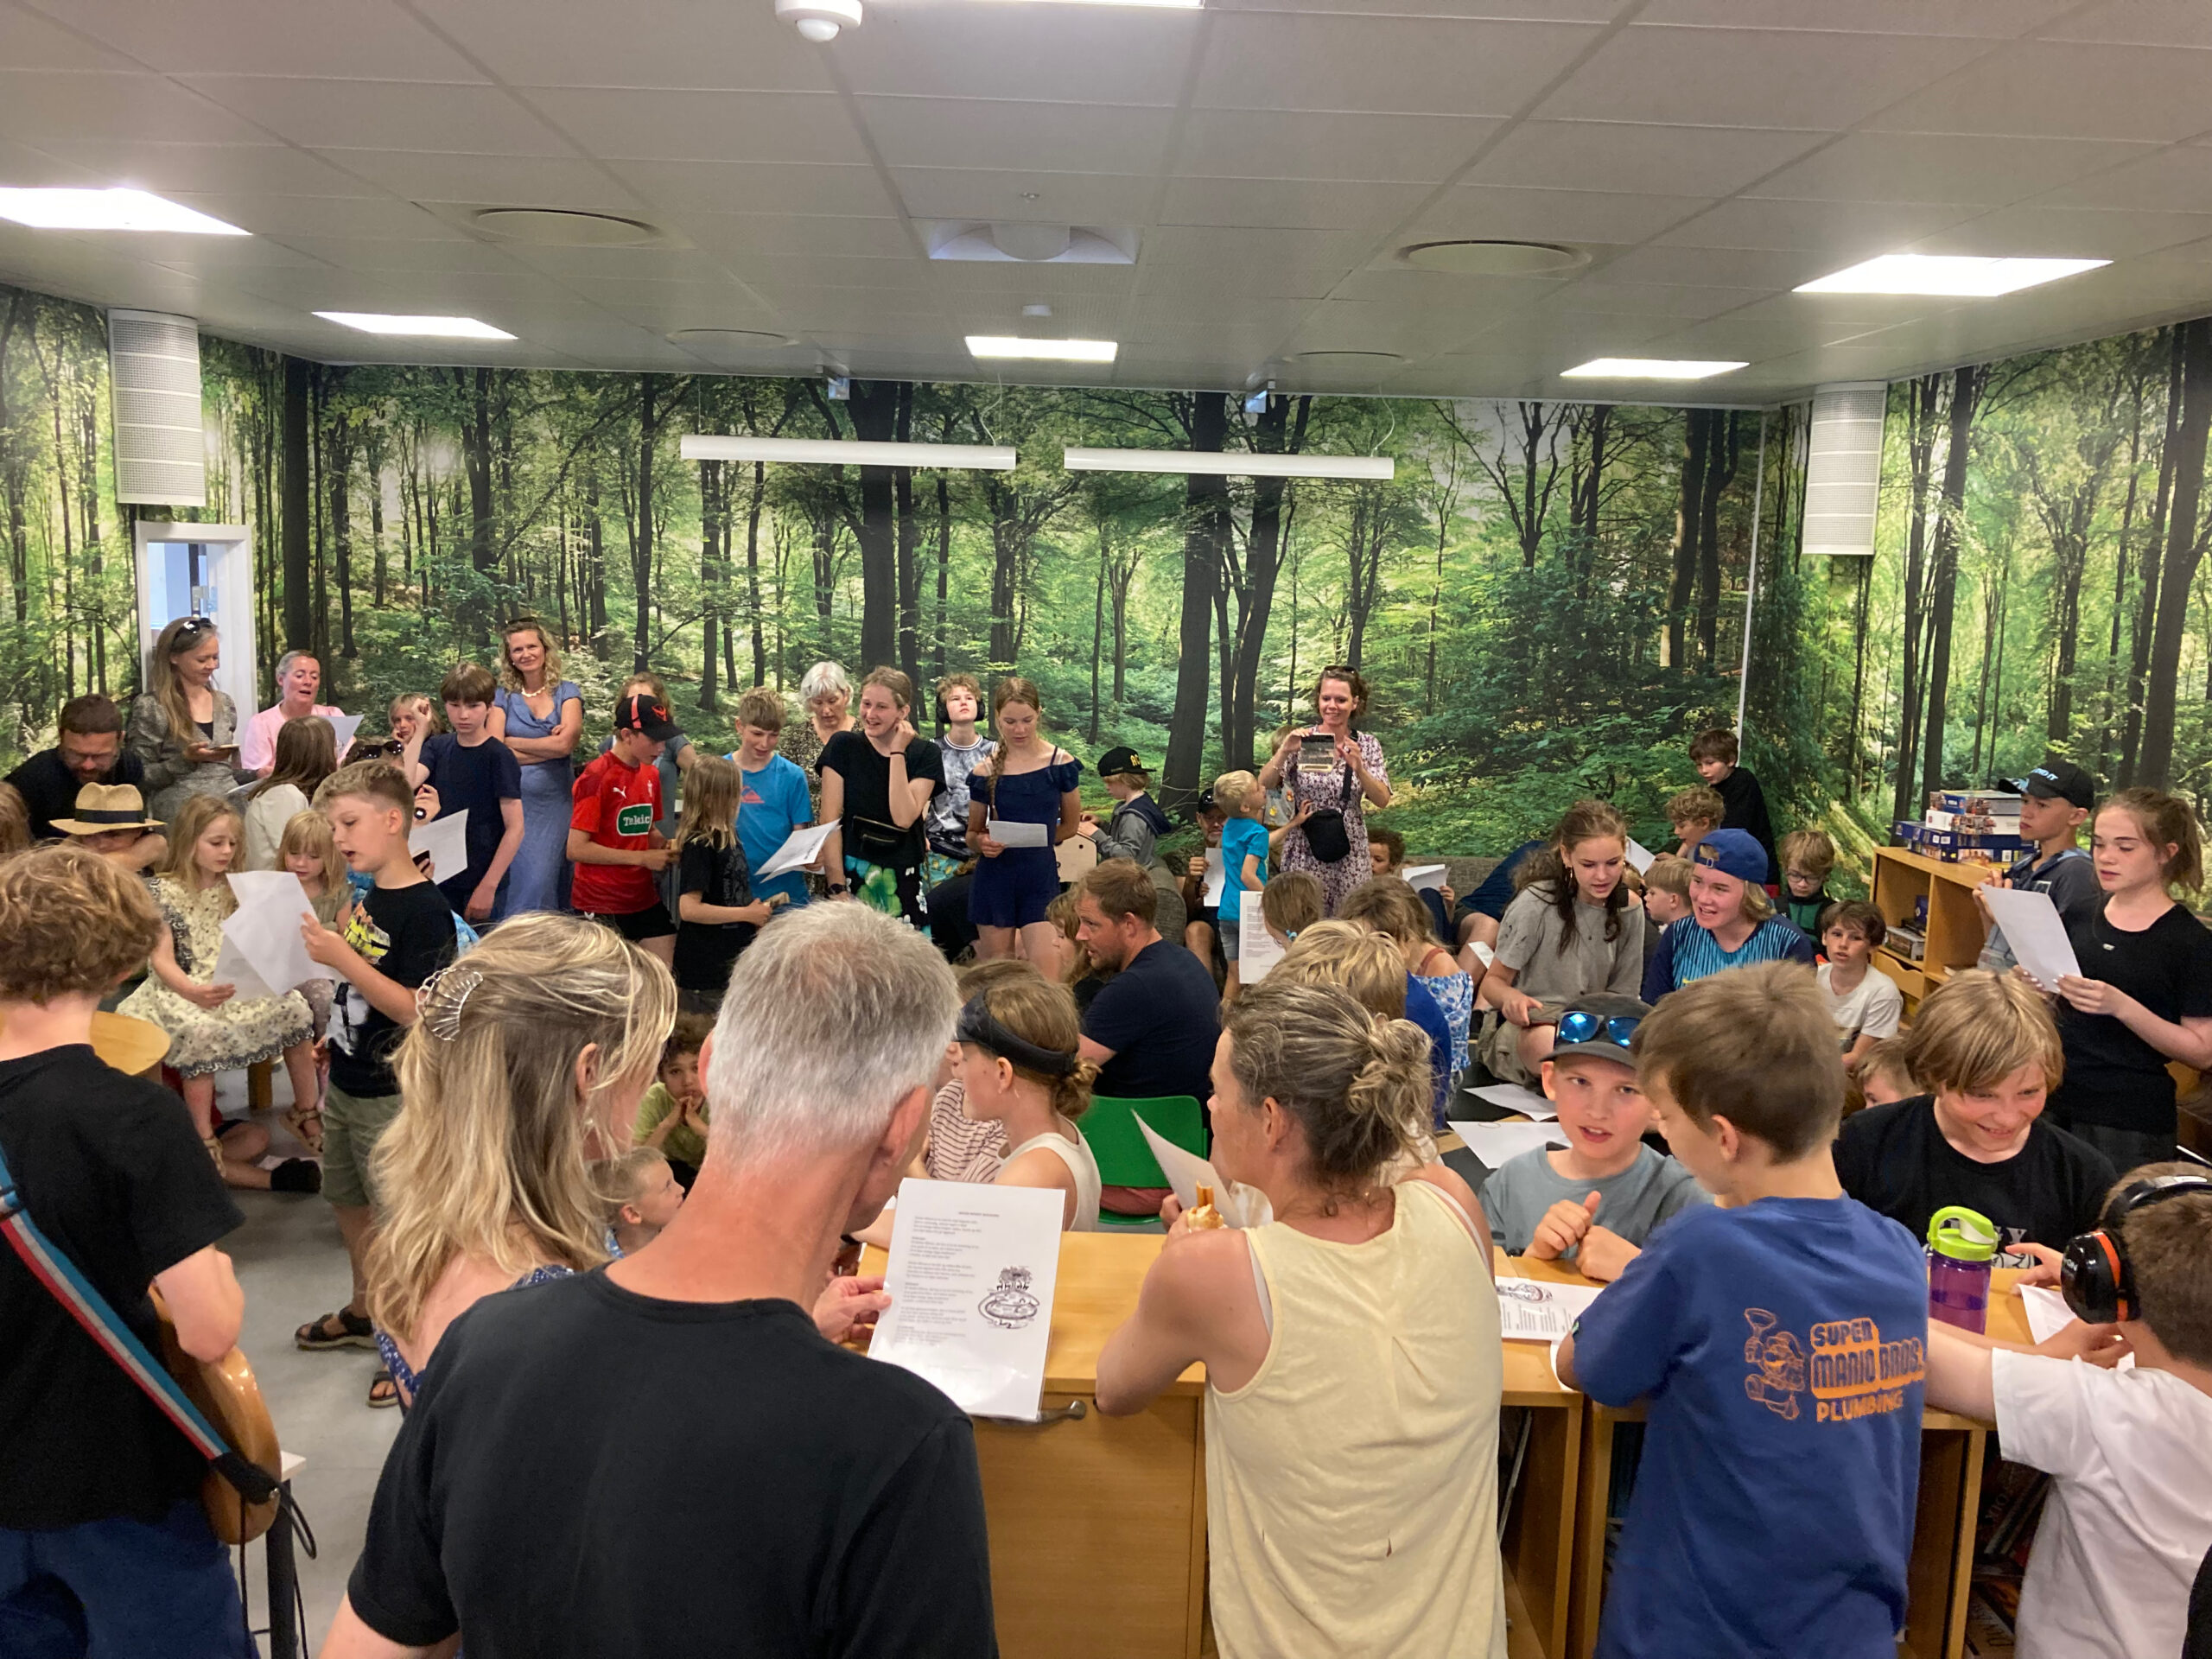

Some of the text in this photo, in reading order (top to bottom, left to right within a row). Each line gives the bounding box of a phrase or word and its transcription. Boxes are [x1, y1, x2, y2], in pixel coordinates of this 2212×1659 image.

[1813, 1319, 1873, 1347] SUPER
[1814, 1348, 1876, 1388] MARIO
[1817, 1391, 1903, 1422] PLUMBING
